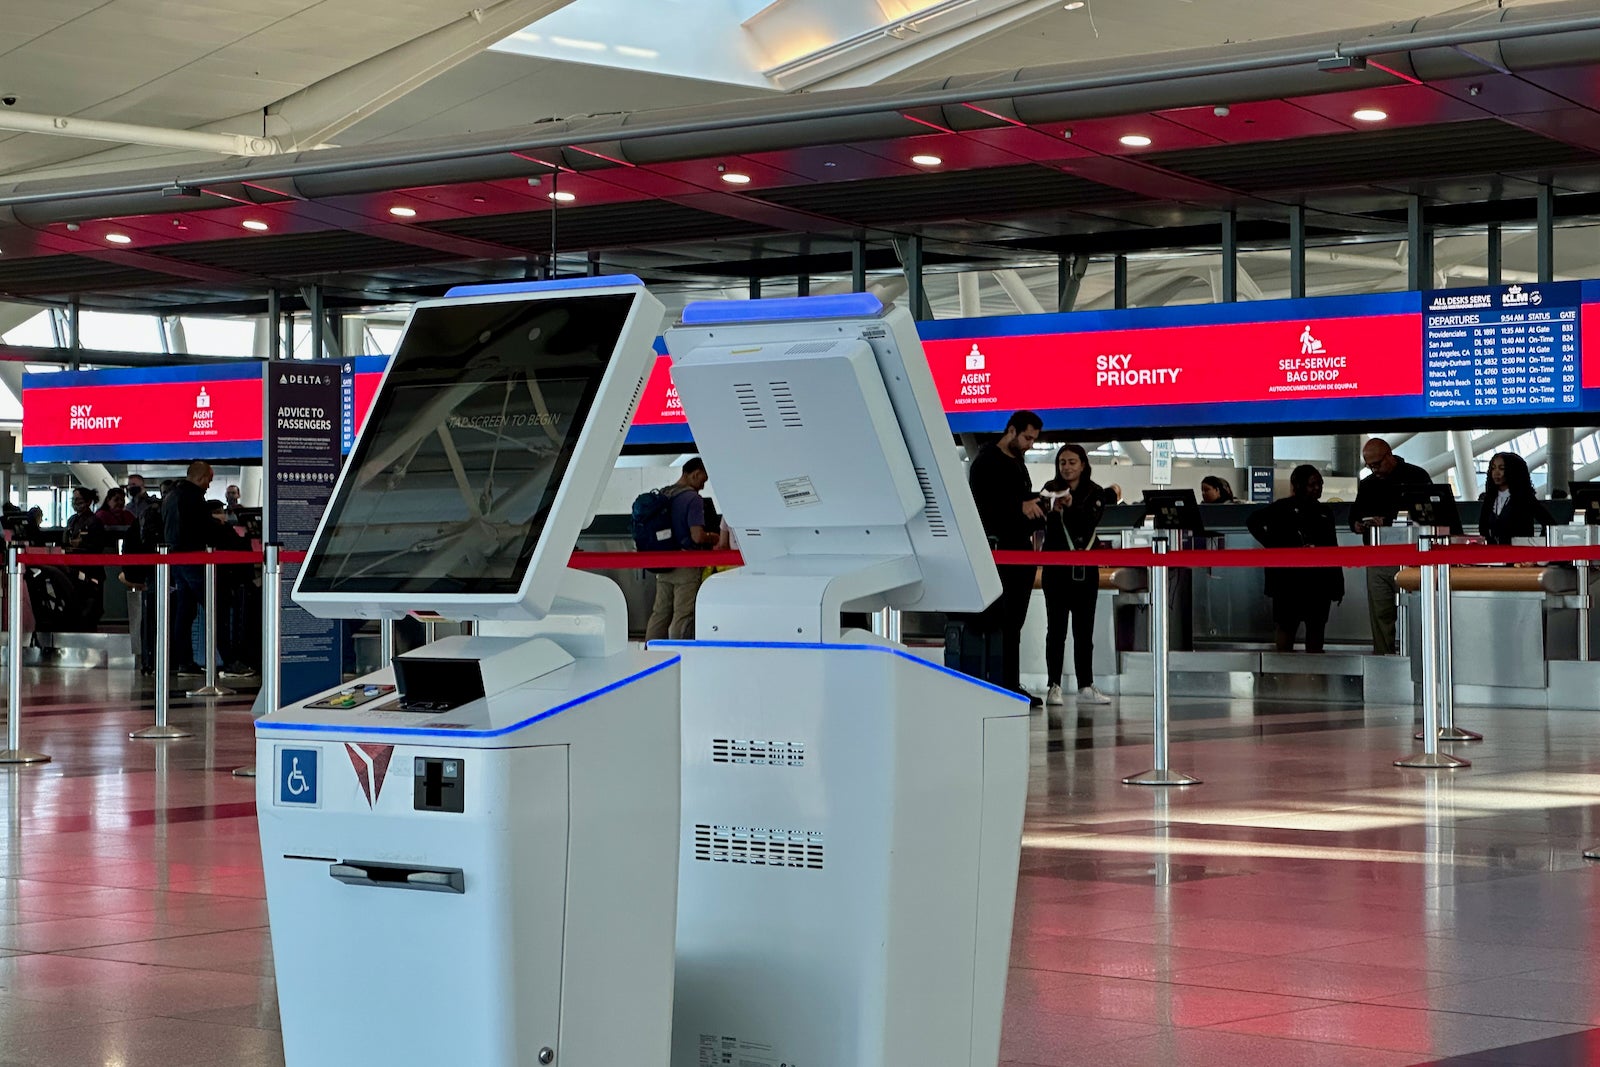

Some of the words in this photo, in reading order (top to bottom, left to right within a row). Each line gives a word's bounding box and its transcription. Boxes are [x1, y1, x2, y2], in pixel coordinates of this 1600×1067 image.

[1447, 296, 1468, 304] DESKS
[1470, 295, 1491, 303] SERVE
[1502, 293, 1528, 303] KLM
[1429, 315, 1480, 326] DEPARTURES
[1429, 330, 1467, 338] Providenciales
[1097, 354, 1132, 370] SKY
[1279, 357, 1346, 370] SELF-SERVICE
[1429, 360, 1471, 368] Raleigh-Durham
[290, 375, 321, 384] DELTA
[961, 373, 991, 384] AGENT
[1097, 369, 1180, 386] PRIORITY
[1287, 372, 1308, 382] BAG
[1310, 370, 1339, 381] DROP
[961, 385, 991, 395] ASSIST
[1269, 384, 1326, 392] AUTODOCUMENTACIÓN
[666, 398, 682, 408] ASS
[70, 405, 92, 417] SKY
[193, 410, 213, 419] AGENT
[278, 407, 310, 417] ADVICE
[312, 408, 324, 418] TO
[70, 417, 120, 430] PRIORITY
[193, 420, 214, 428] ASSIST
[278, 419, 331, 430] PASSENGERS
[448, 416, 469, 428] TAP
[470, 415, 510, 428] SCREEN
[512, 415, 526, 426] TO
[528, 413, 561, 425] BEGIN
